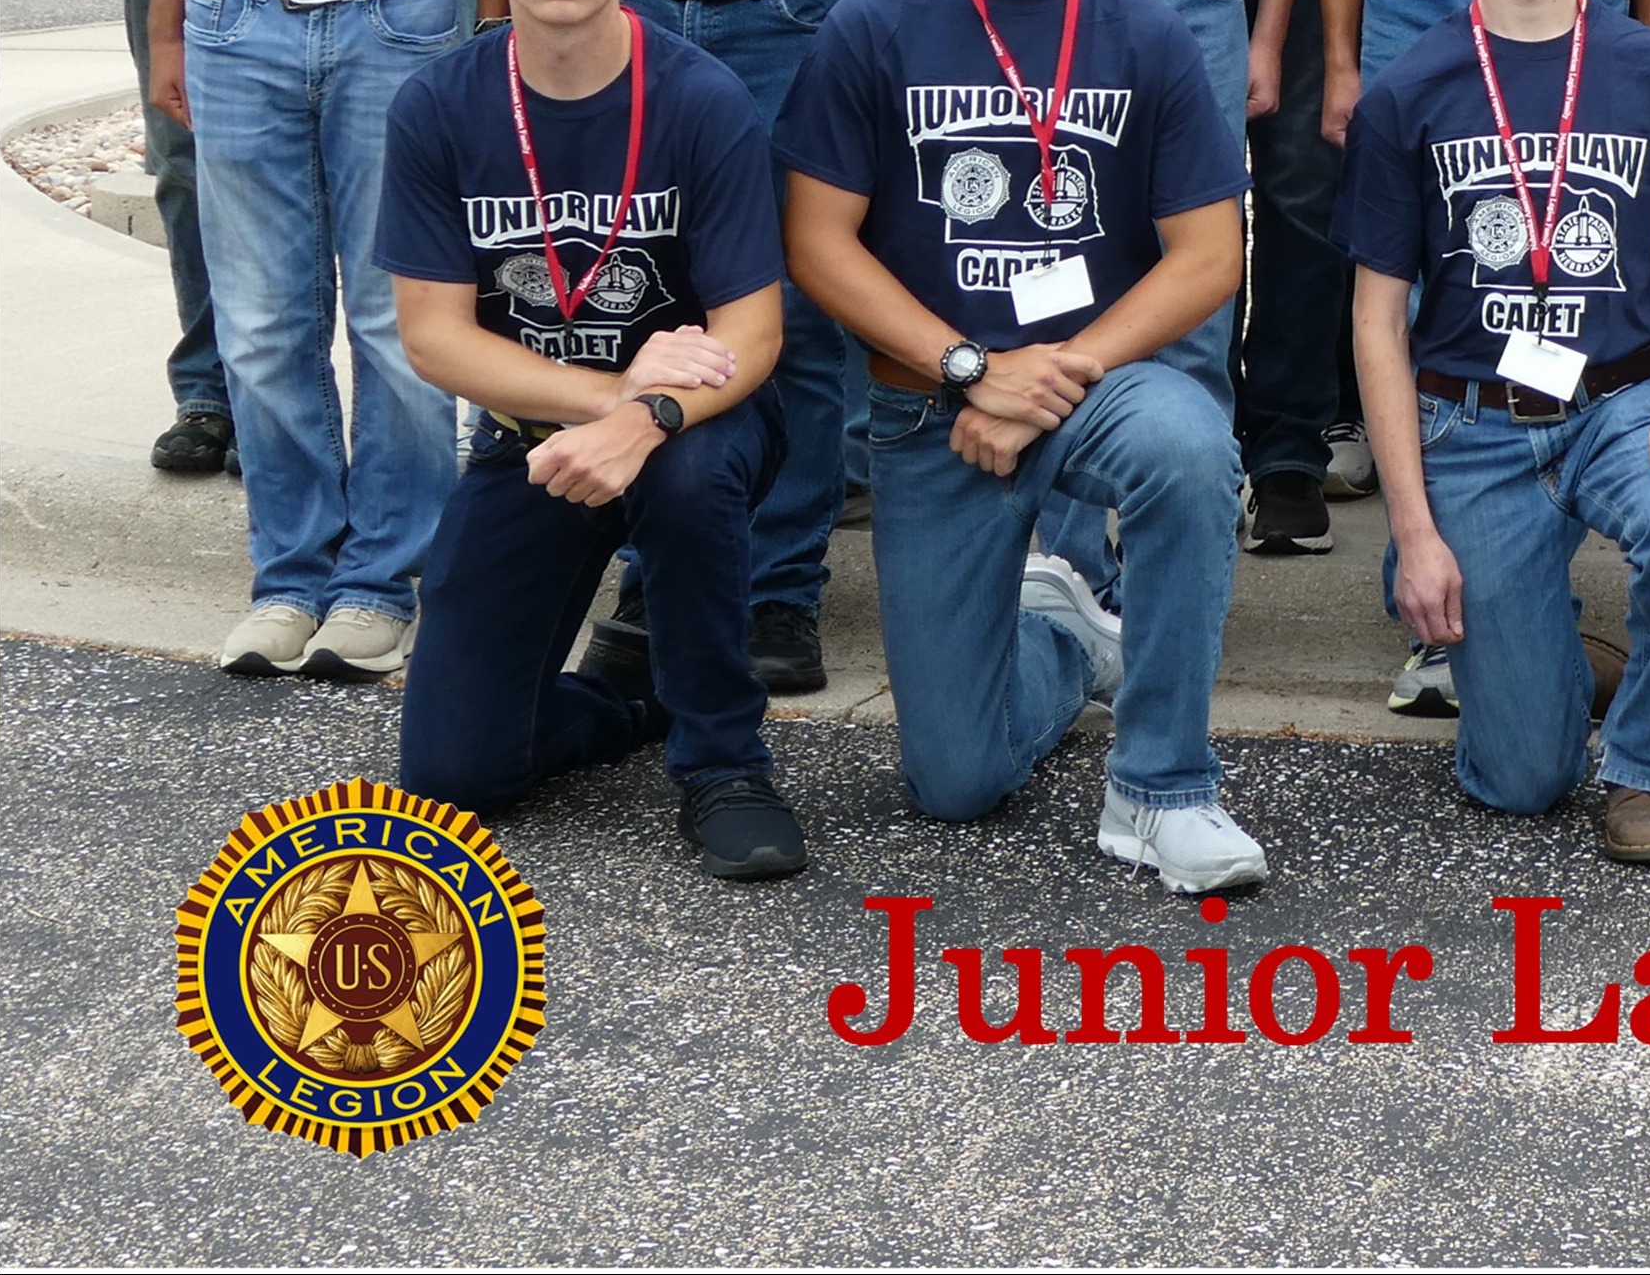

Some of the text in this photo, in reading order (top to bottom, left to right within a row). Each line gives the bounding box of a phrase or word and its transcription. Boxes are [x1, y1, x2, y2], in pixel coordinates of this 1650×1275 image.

[906, 85, 1043, 145] JUNIOR
[1431, 132, 1648, 200] JUNIOR LAW
[461, 186, 679, 248] UNIOR LAW
[951, 201, 992, 216] LEGION
[1555, 216, 1580, 242] STATE
[1557, 250, 1610, 274] NEBRASKA
[1482, 293, 1585, 338] CADET
